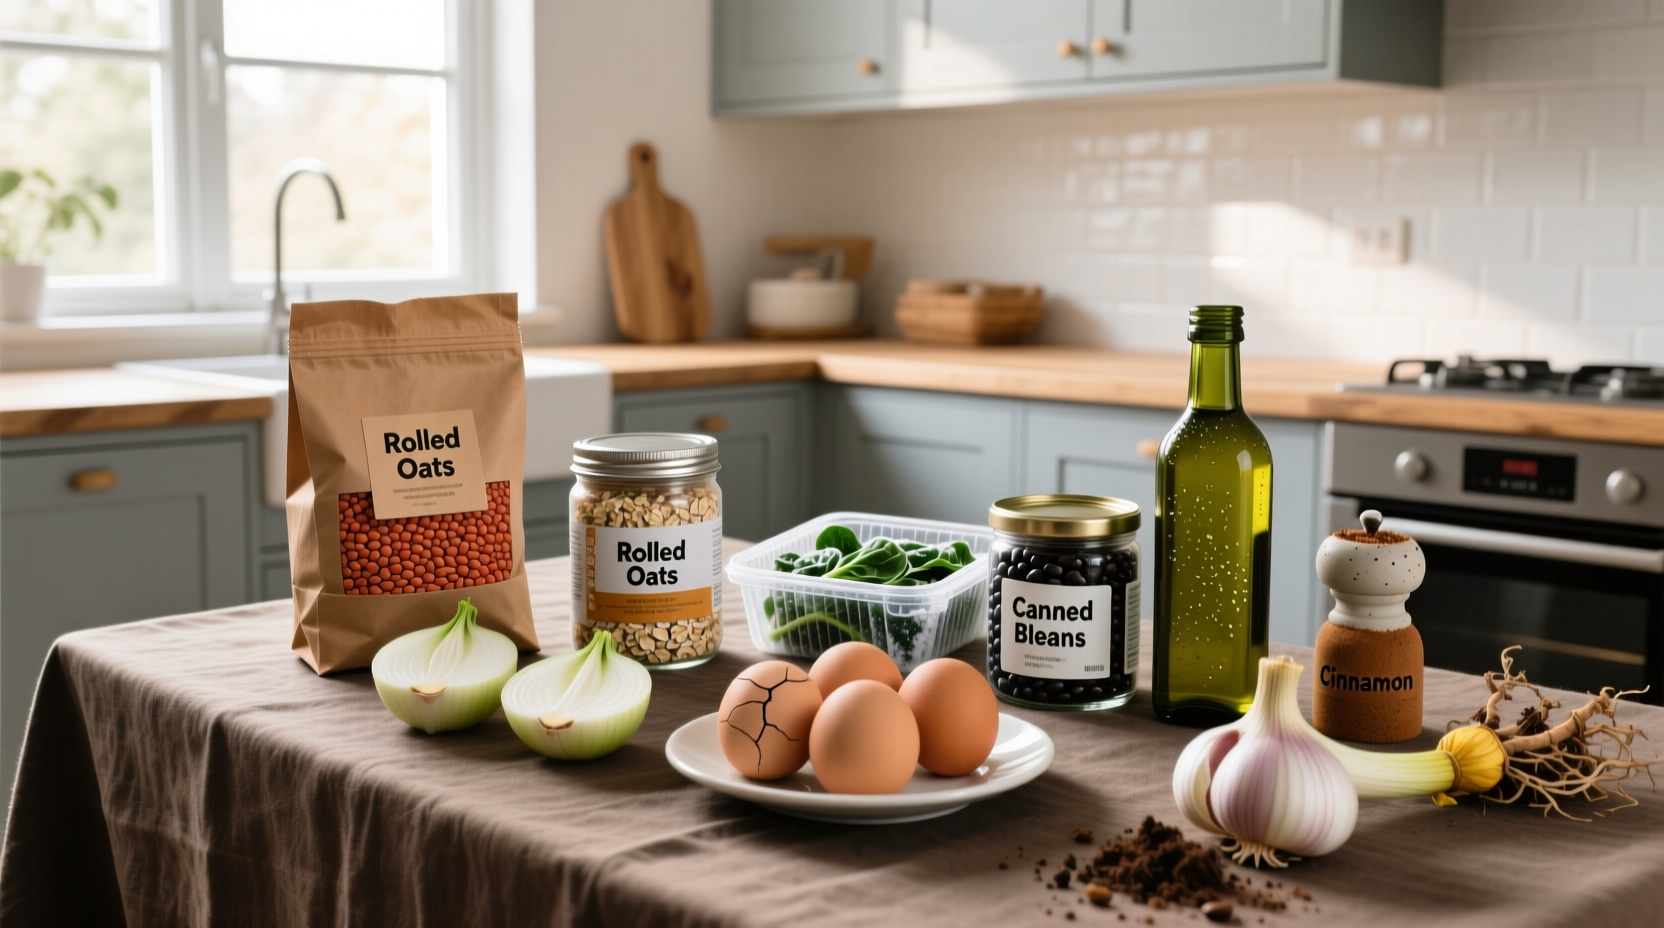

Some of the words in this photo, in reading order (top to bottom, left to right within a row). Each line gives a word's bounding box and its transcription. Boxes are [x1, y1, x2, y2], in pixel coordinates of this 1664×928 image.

[383, 425, 461, 454] Rolled
[397, 457, 455, 480] Oats
[617, 539, 686, 563] Rolled
[626, 565, 679, 587] Oats
[1012, 596, 1093, 622] Canned
[1014, 622, 1086, 648] Bleans
[1320, 664, 1413, 692] Cinnamon
